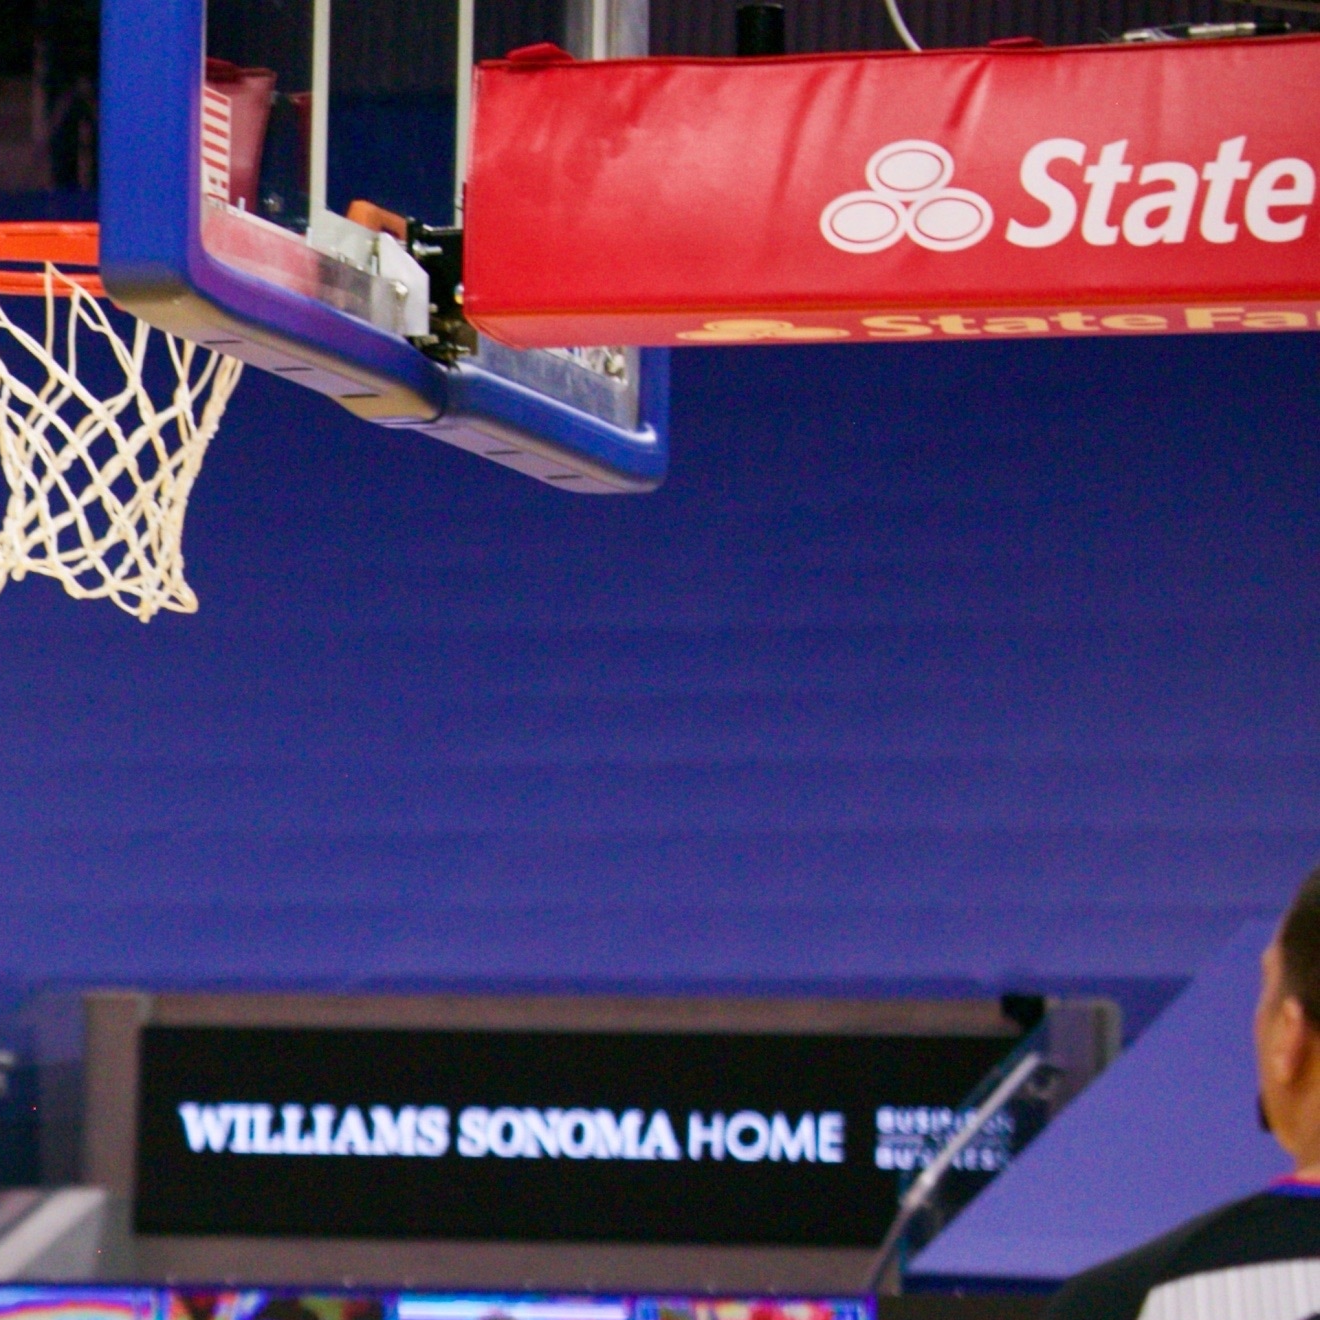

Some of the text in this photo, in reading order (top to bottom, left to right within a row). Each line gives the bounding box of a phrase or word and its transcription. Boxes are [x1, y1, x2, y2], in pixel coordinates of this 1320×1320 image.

[1005, 135, 1316, 248] State
[861, 306, 1320, 338] State Fa
[178, 1102, 846, 1163] WILLIAMS SONOMA HOME
